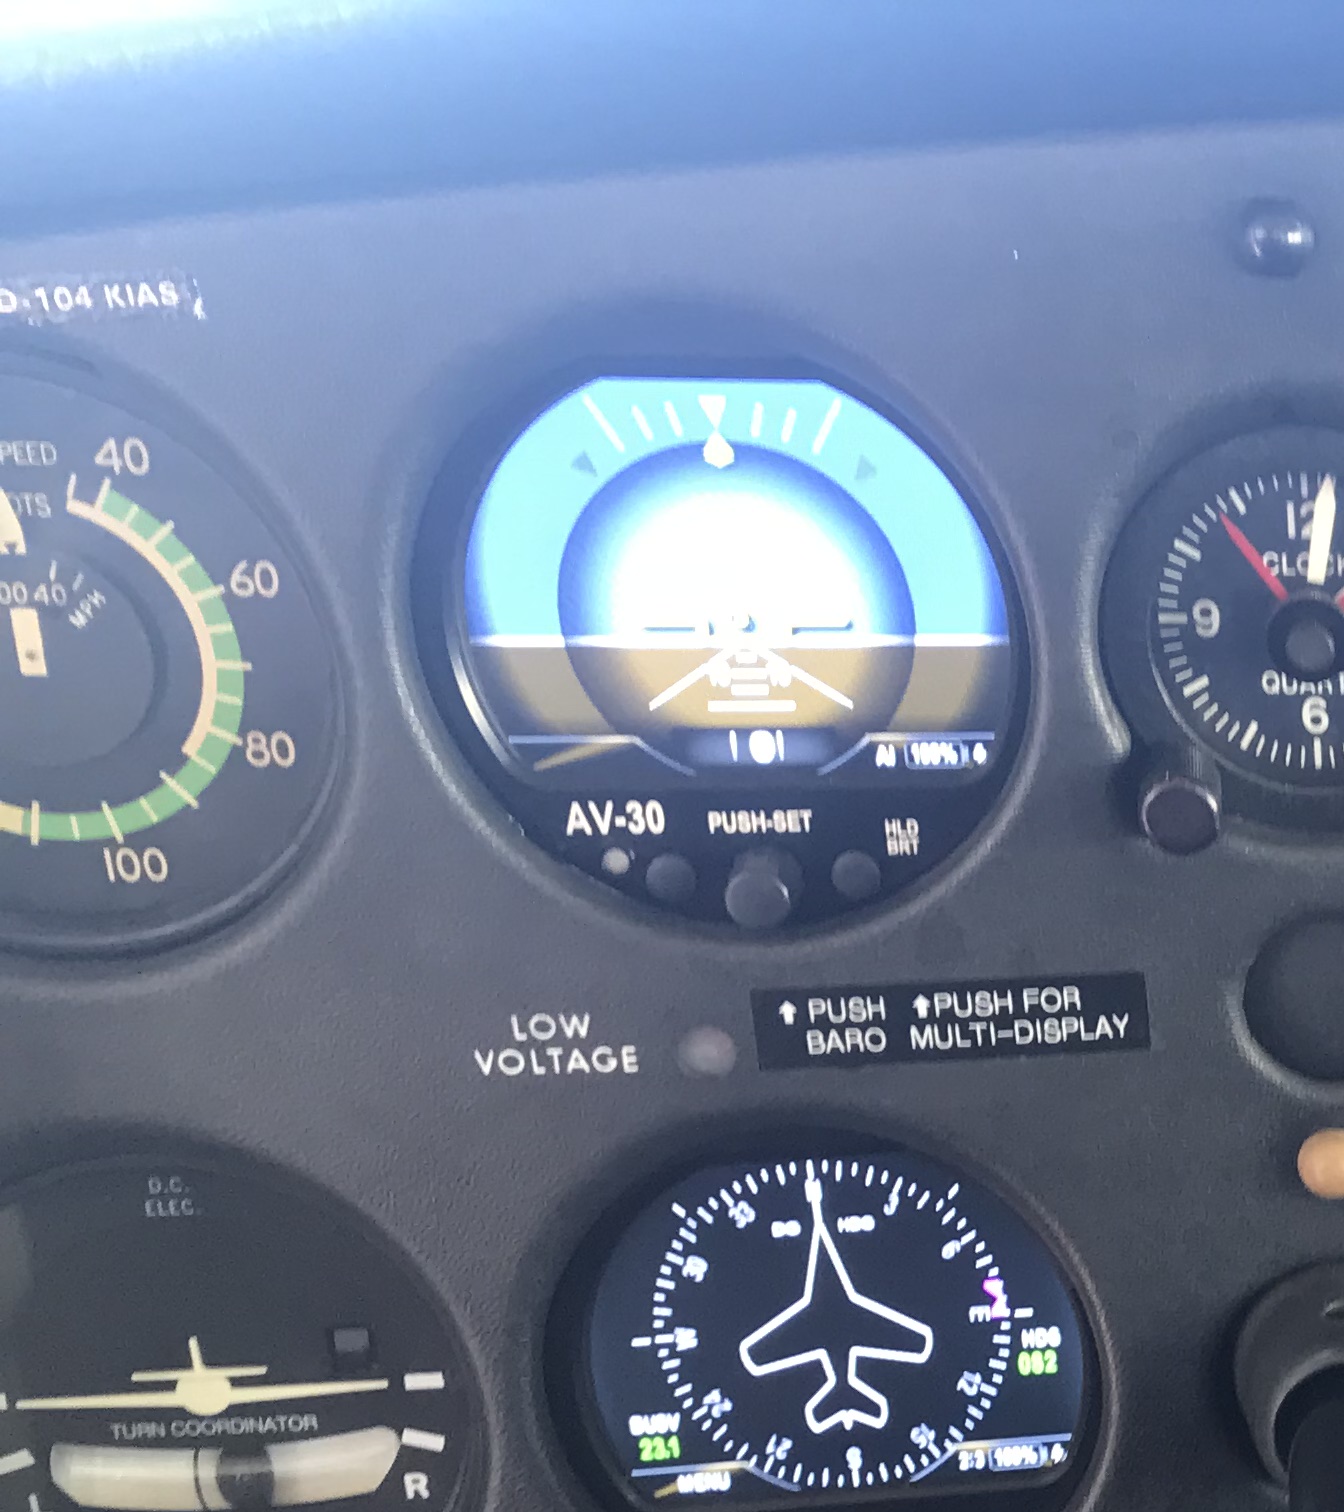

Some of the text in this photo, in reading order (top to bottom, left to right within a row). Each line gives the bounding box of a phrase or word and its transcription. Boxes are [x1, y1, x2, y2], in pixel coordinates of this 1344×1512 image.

[103, 279, 180, 310] KIAS
[94, 436, 150, 477] 40
[34, 582, 67, 607] 40
[230, 560, 278, 599] 60
[68, 589, 106, 629] MPH
[1192, 598, 1221, 639] 9
[1301, 695, 1330, 735] 6
[245, 731, 295, 768] 80
[566, 800, 666, 836] AV-30
[708, 808, 812, 835] PUSH-SET
[103, 847, 168, 883] 100
[807, 995, 886, 1024] PUSH
[934, 985, 1082, 1018] PUSH FOR
[510, 1012, 591, 1041] LOW
[806, 1025, 887, 1055] BARO
[909, 1013, 1130, 1050] MULTI-DISPLAY
[473, 1045, 640, 1076] VOLTAGE
[941, 1239, 961, 1260] 6
[1021, 1326, 1062, 1349] HDG
[110, 1414, 318, 1440] TURN COORDINATOR
[403, 1471, 430, 1500] R
